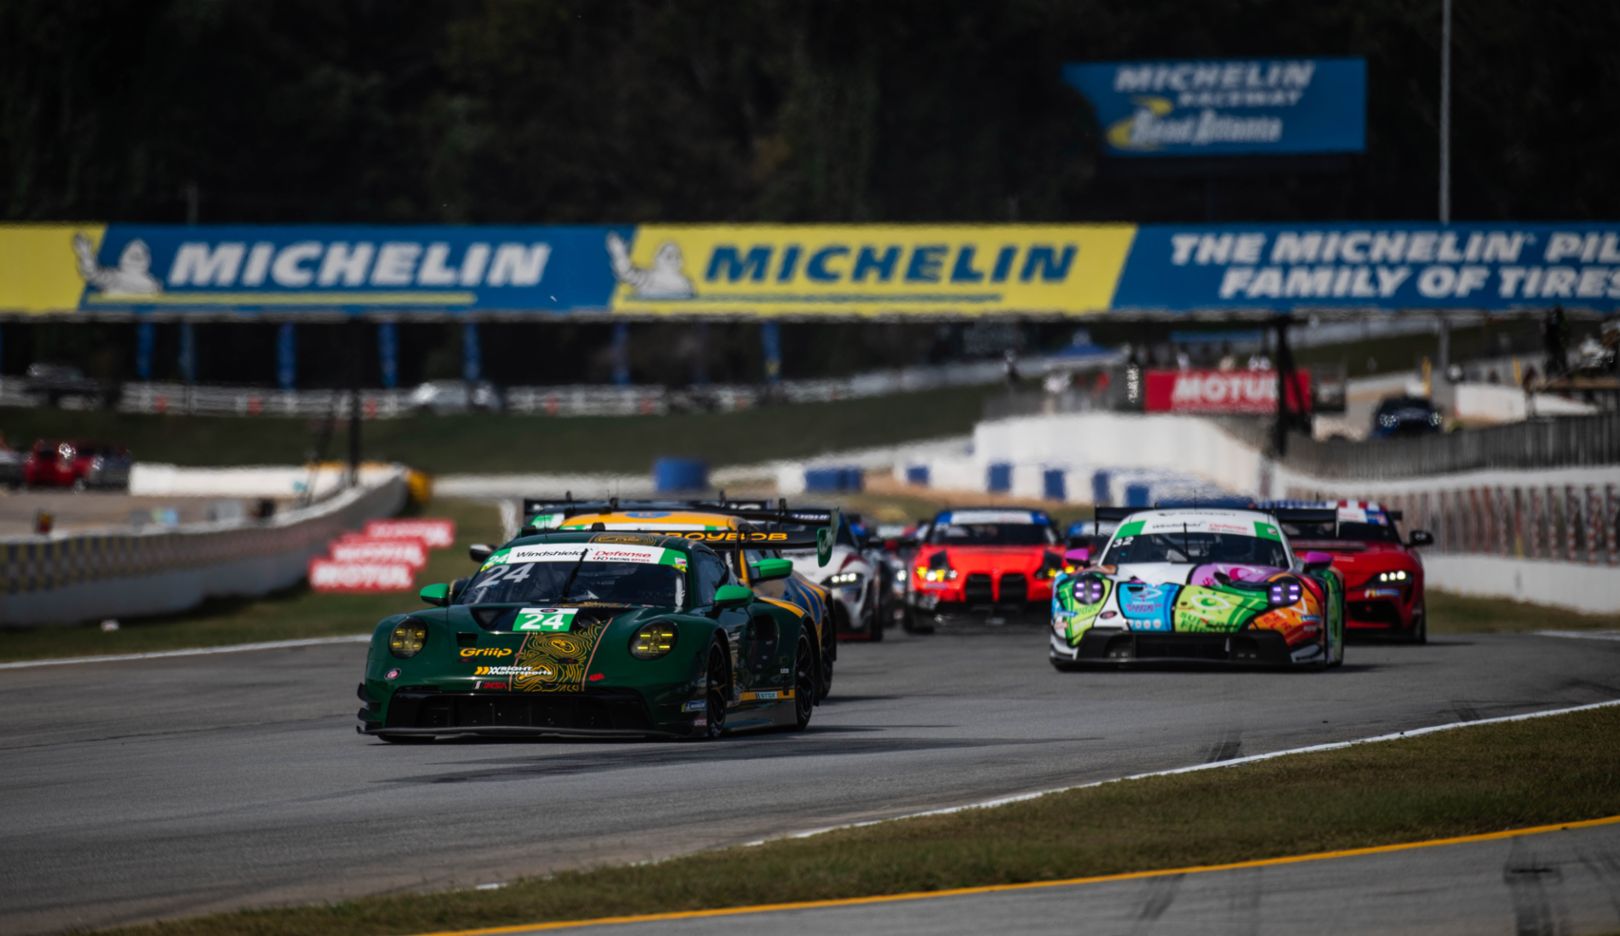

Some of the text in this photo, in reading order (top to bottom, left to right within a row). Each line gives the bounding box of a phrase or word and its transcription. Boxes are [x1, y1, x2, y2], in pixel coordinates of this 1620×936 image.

[1114, 60, 1316, 92] MICHELIN
[168, 242, 552, 287] MICHELIN
[702, 244, 1079, 284] MICHELIN
[1171, 234, 1267, 265] THE
[1218, 268, 1413, 299] FAMILY
[1417, 267, 1490, 298] OF
[594, 550, 652, 558] Defense
[1111, 536, 1134, 548] 32
[475, 562, 536, 589] 24
[520, 614, 565, 630] 24
